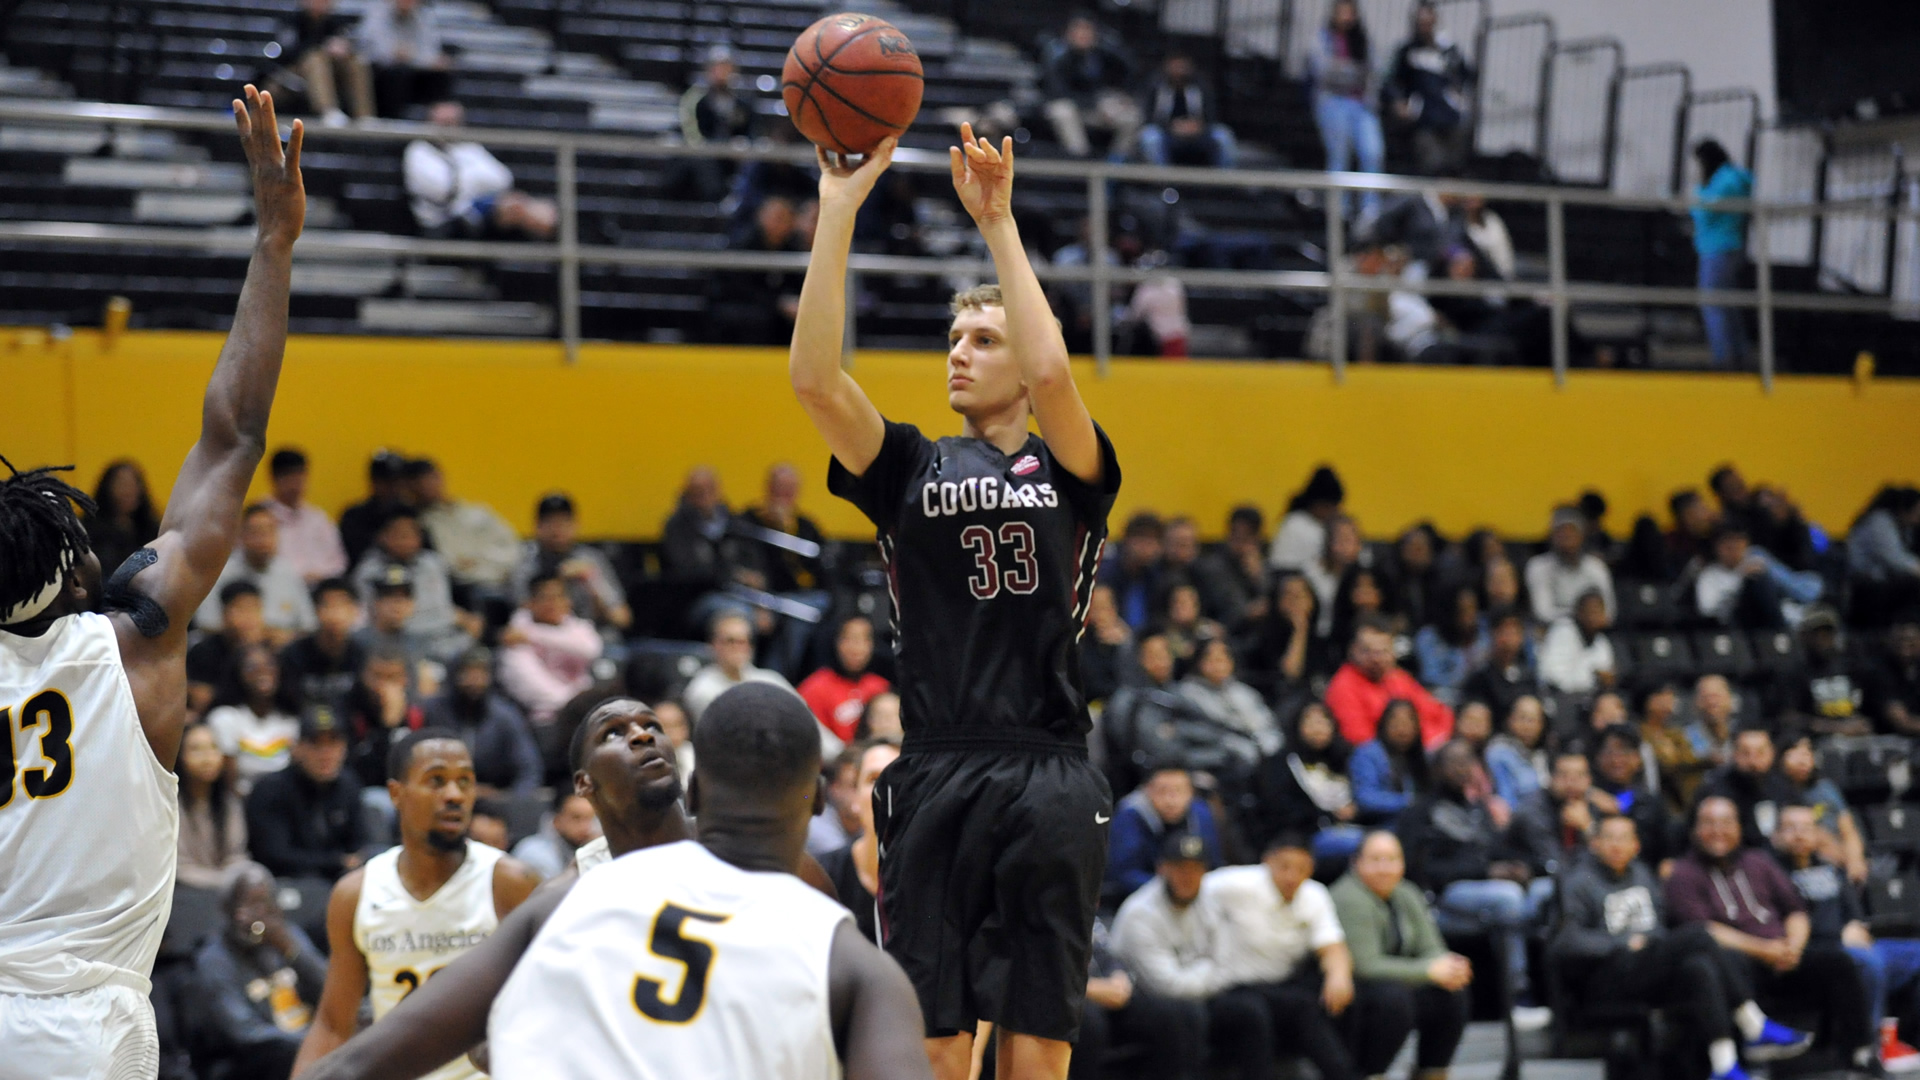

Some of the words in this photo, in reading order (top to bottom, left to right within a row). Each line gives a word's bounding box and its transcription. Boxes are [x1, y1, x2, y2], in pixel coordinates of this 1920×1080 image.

[922, 476, 1059, 518] COUGARS
[960, 521, 1039, 600] 33
[363, 929, 396, 952] Los
[630, 899, 734, 1025] 5
[394, 966, 448, 1003] 2
